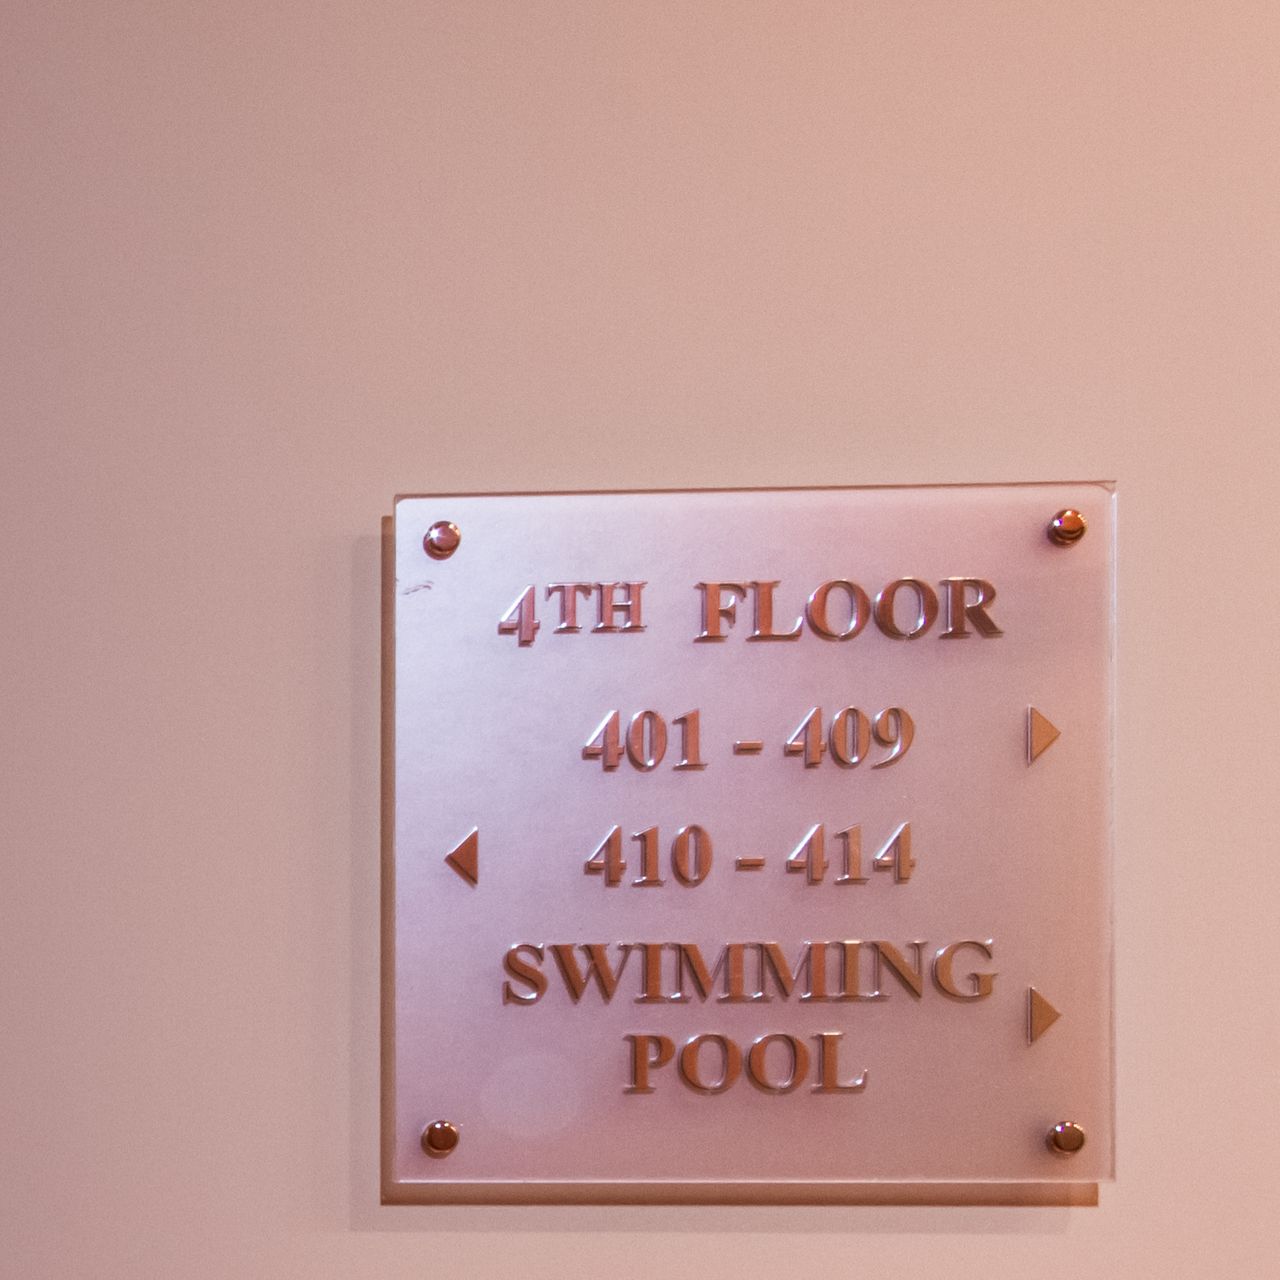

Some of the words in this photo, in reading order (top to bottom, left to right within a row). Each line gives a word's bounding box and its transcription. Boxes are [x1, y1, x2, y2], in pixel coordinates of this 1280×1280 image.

[497, 580, 648, 646] 4TH
[694, 576, 1004, 642] FLOOR
[582, 707, 708, 771] 401
[784, 705, 916, 770] 409
[584, 824, 713, 888] 410
[786, 821, 916, 886] 414
[501, 939, 1000, 1006] SWIMMING
[622, 1031, 869, 1096] POOL
